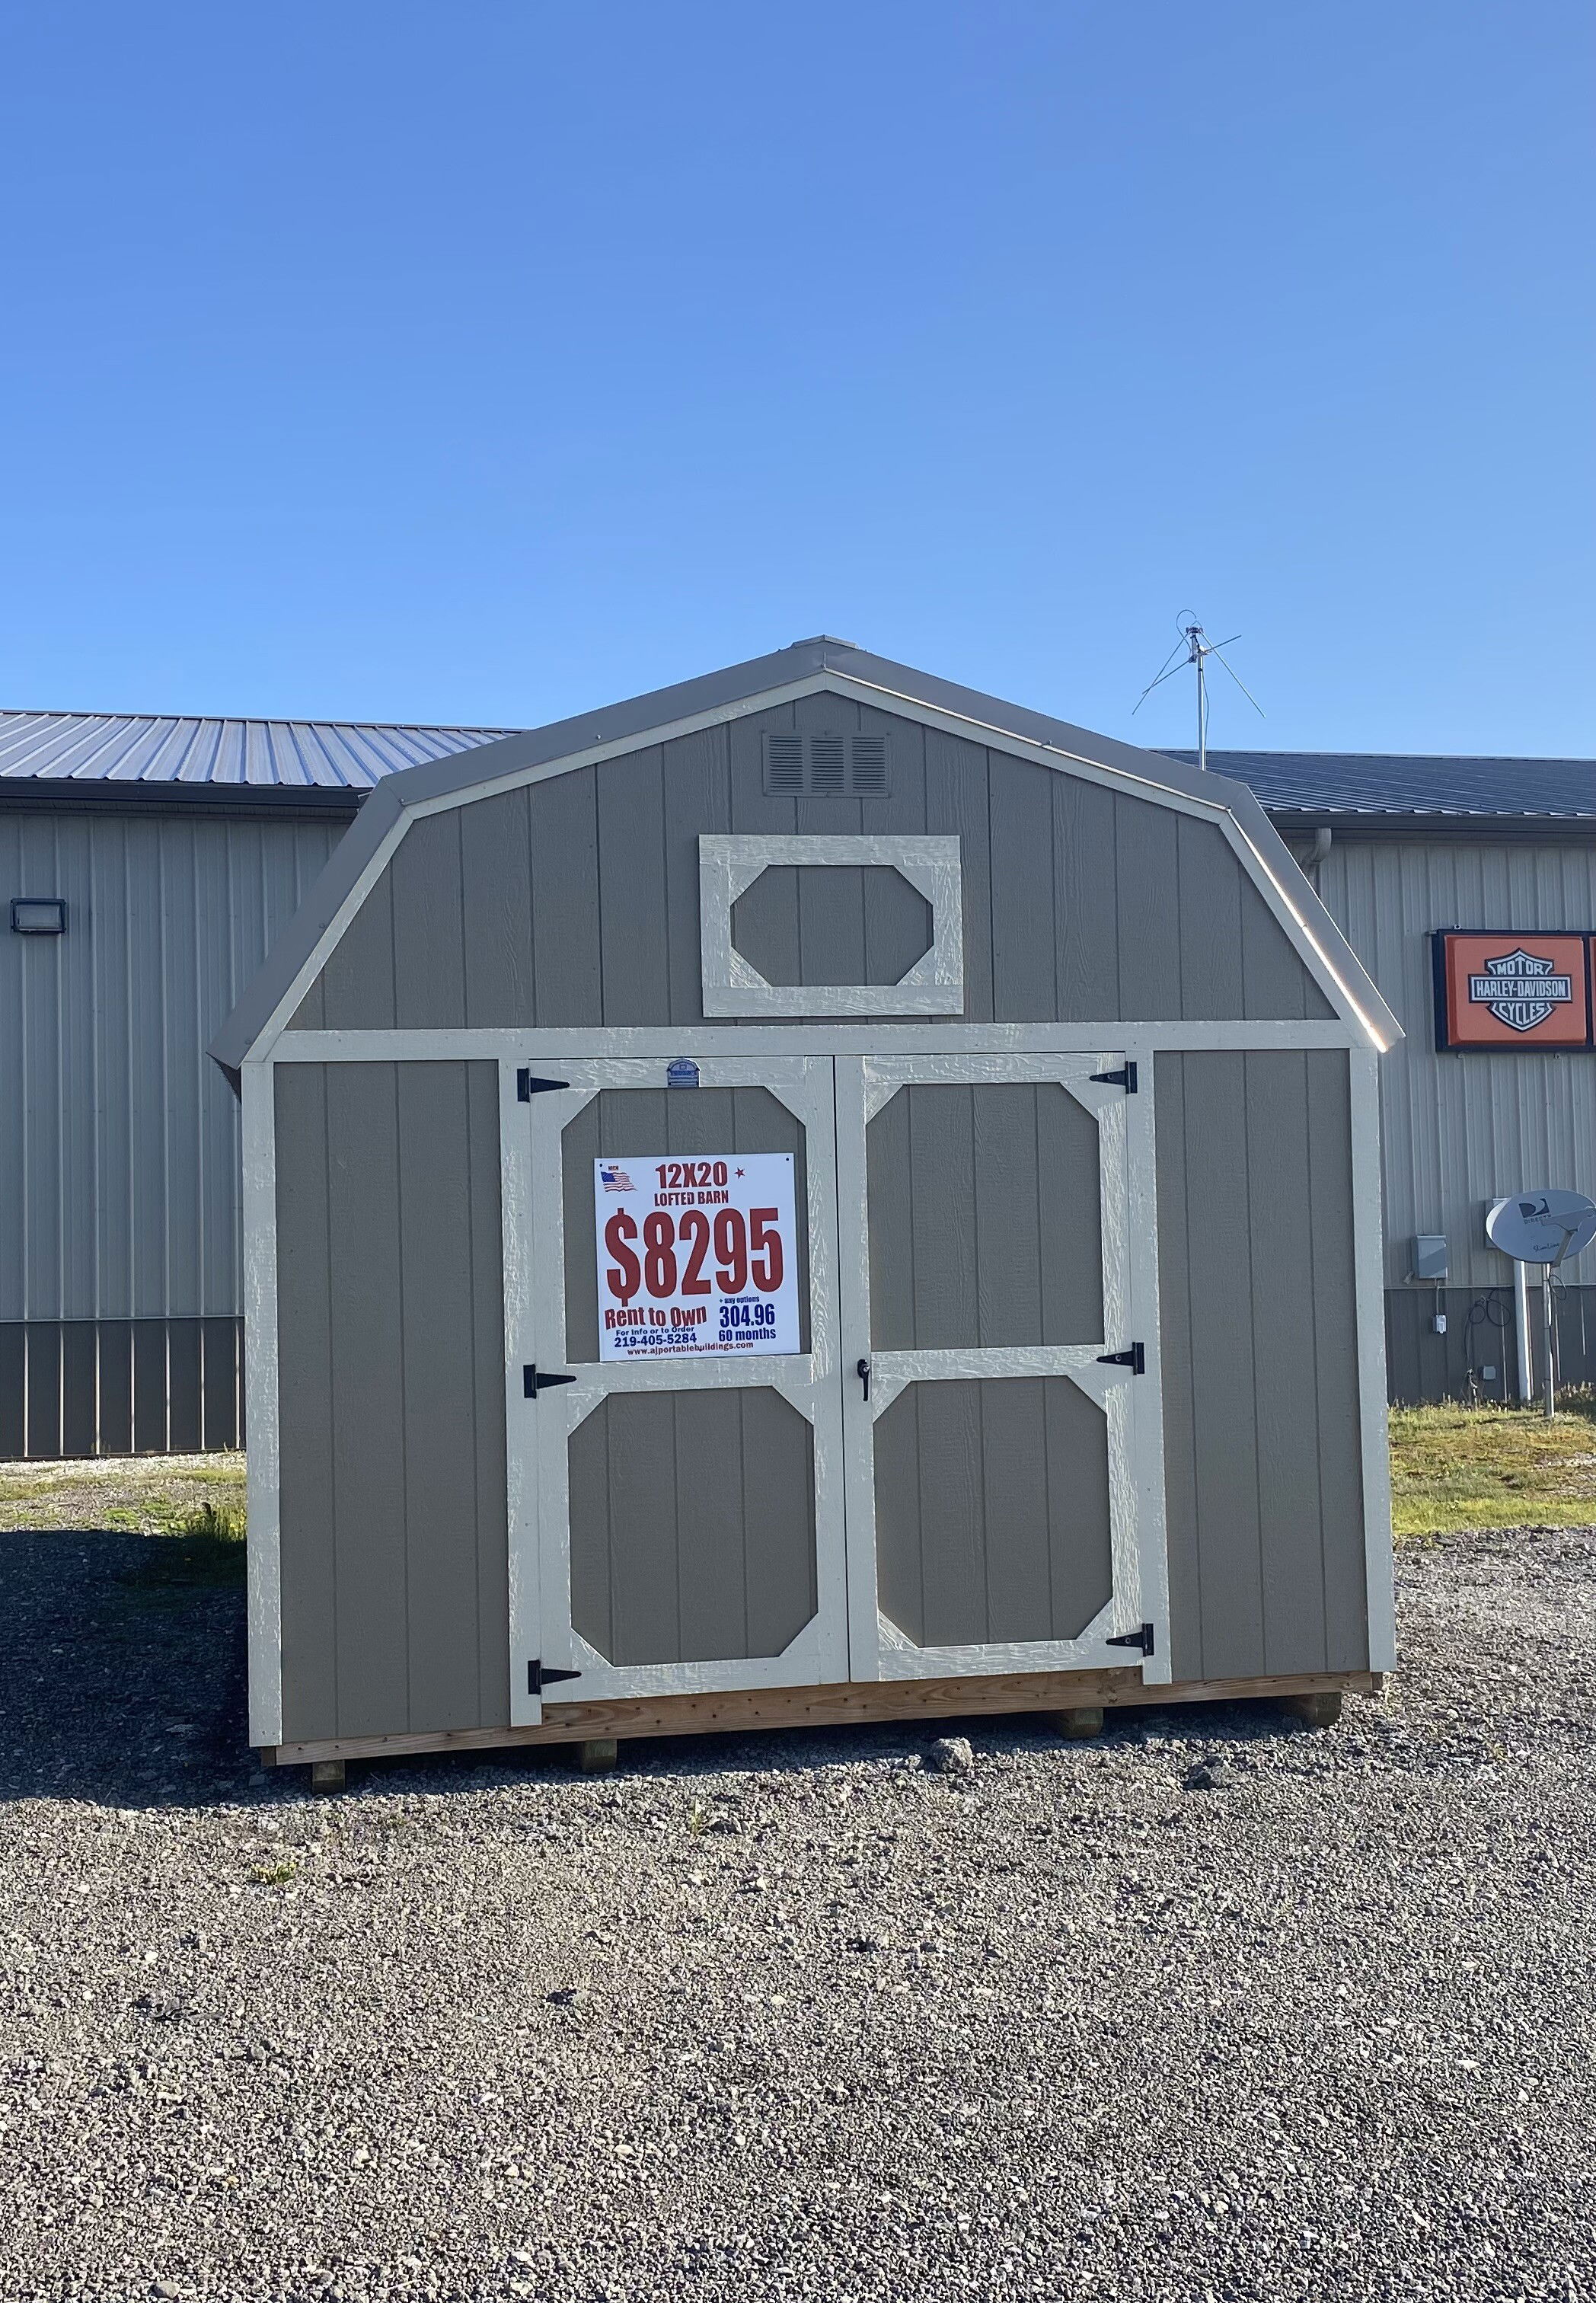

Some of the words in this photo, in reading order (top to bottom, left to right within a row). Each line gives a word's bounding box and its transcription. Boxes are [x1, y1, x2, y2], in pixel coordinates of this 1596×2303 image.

[1496, 955, 1543, 975] MOTOR
[1476, 980, 1566, 997] HARLEY-DAVIDSON
[1499, 1002, 1546, 1025] CYCLES
[655, 1161, 728, 1189] 12X20
[654, 1192, 694, 1206] LOFTED
[697, 1190, 729, 1205] BARN
[605, 1207, 784, 1307] $8295
[605, 1307, 646, 1330] Rent
[648, 1307, 666, 1326] to
[670, 1306, 707, 1327] Own
[719, 1303, 775, 1328] 304.96
[614, 1333, 697, 1347] 219-405-5284
[719, 1329, 733, 1342] 60
[735, 1327, 776, 1341] months
[627, 1342, 754, 1355] www.ajportablebuildings.com
